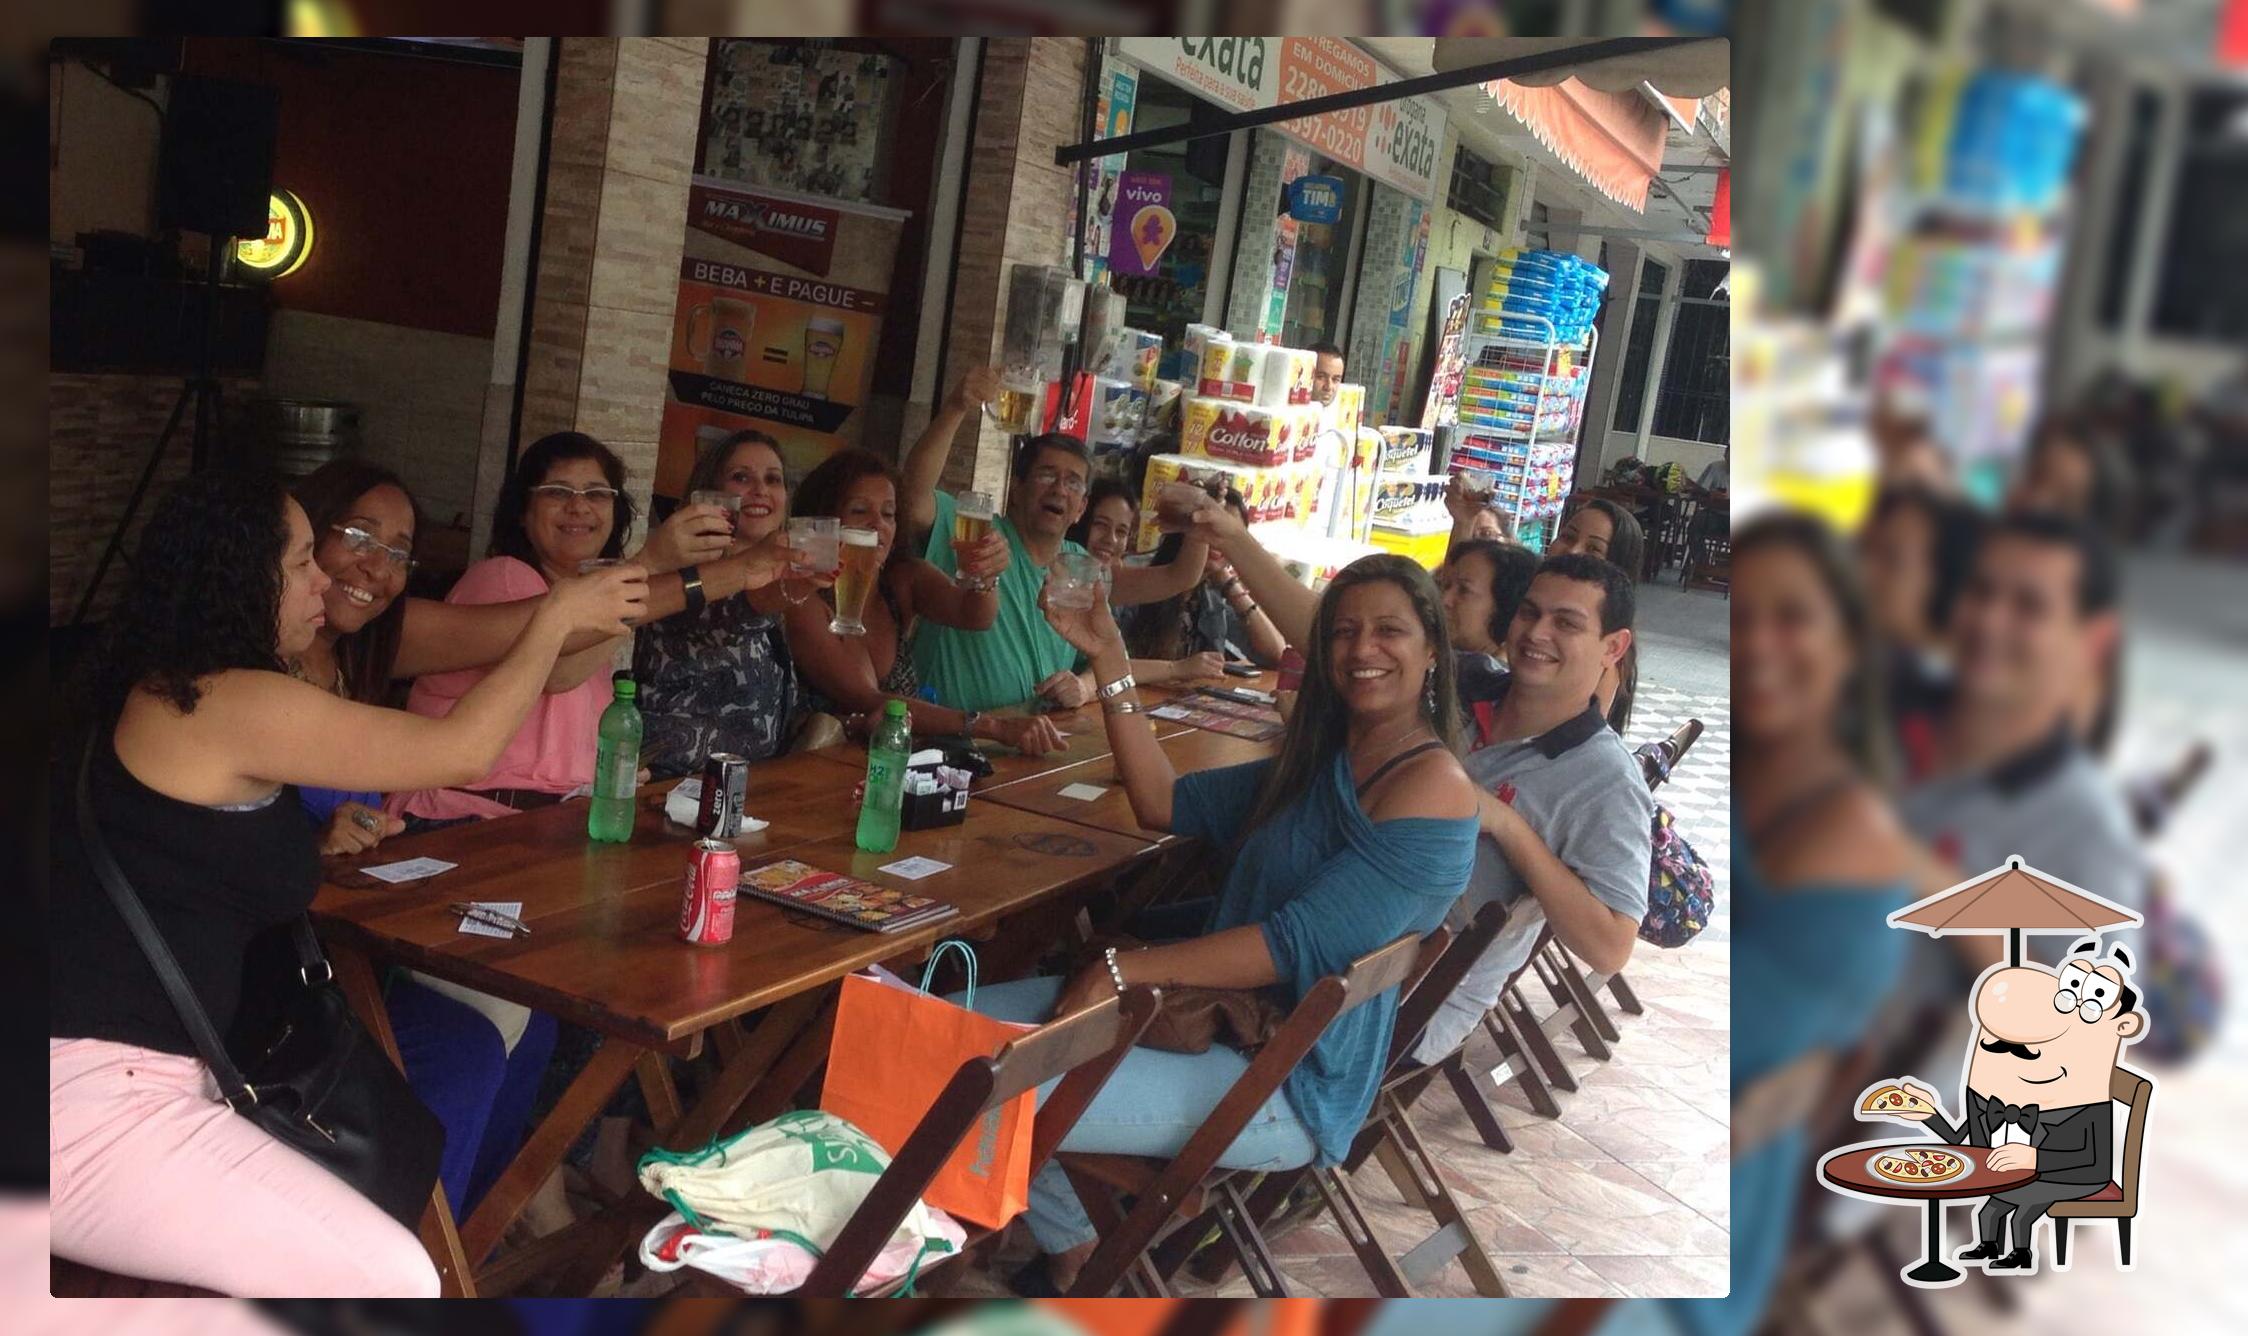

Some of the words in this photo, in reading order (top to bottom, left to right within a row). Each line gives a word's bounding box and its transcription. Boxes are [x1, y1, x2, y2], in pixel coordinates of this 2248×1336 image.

[1293, 42, 1312, 63] EM
[1203, 73, 1219, 95] para
[1392, 121, 1435, 180] exata
[1126, 186, 1162, 203] vivo
[1302, 189, 1330, 207] TIM
[704, 199, 826, 235] MAXIMUS
[694, 262, 747, 288] BEBA
[770, 277, 784, 295] E
[787, 280, 857, 309] PAGUE
[701, 391, 726, 404] PELO
[764, 404, 779, 415] DA
[751, 390, 780, 404] ZERO
[712, 788, 724, 816] zero
